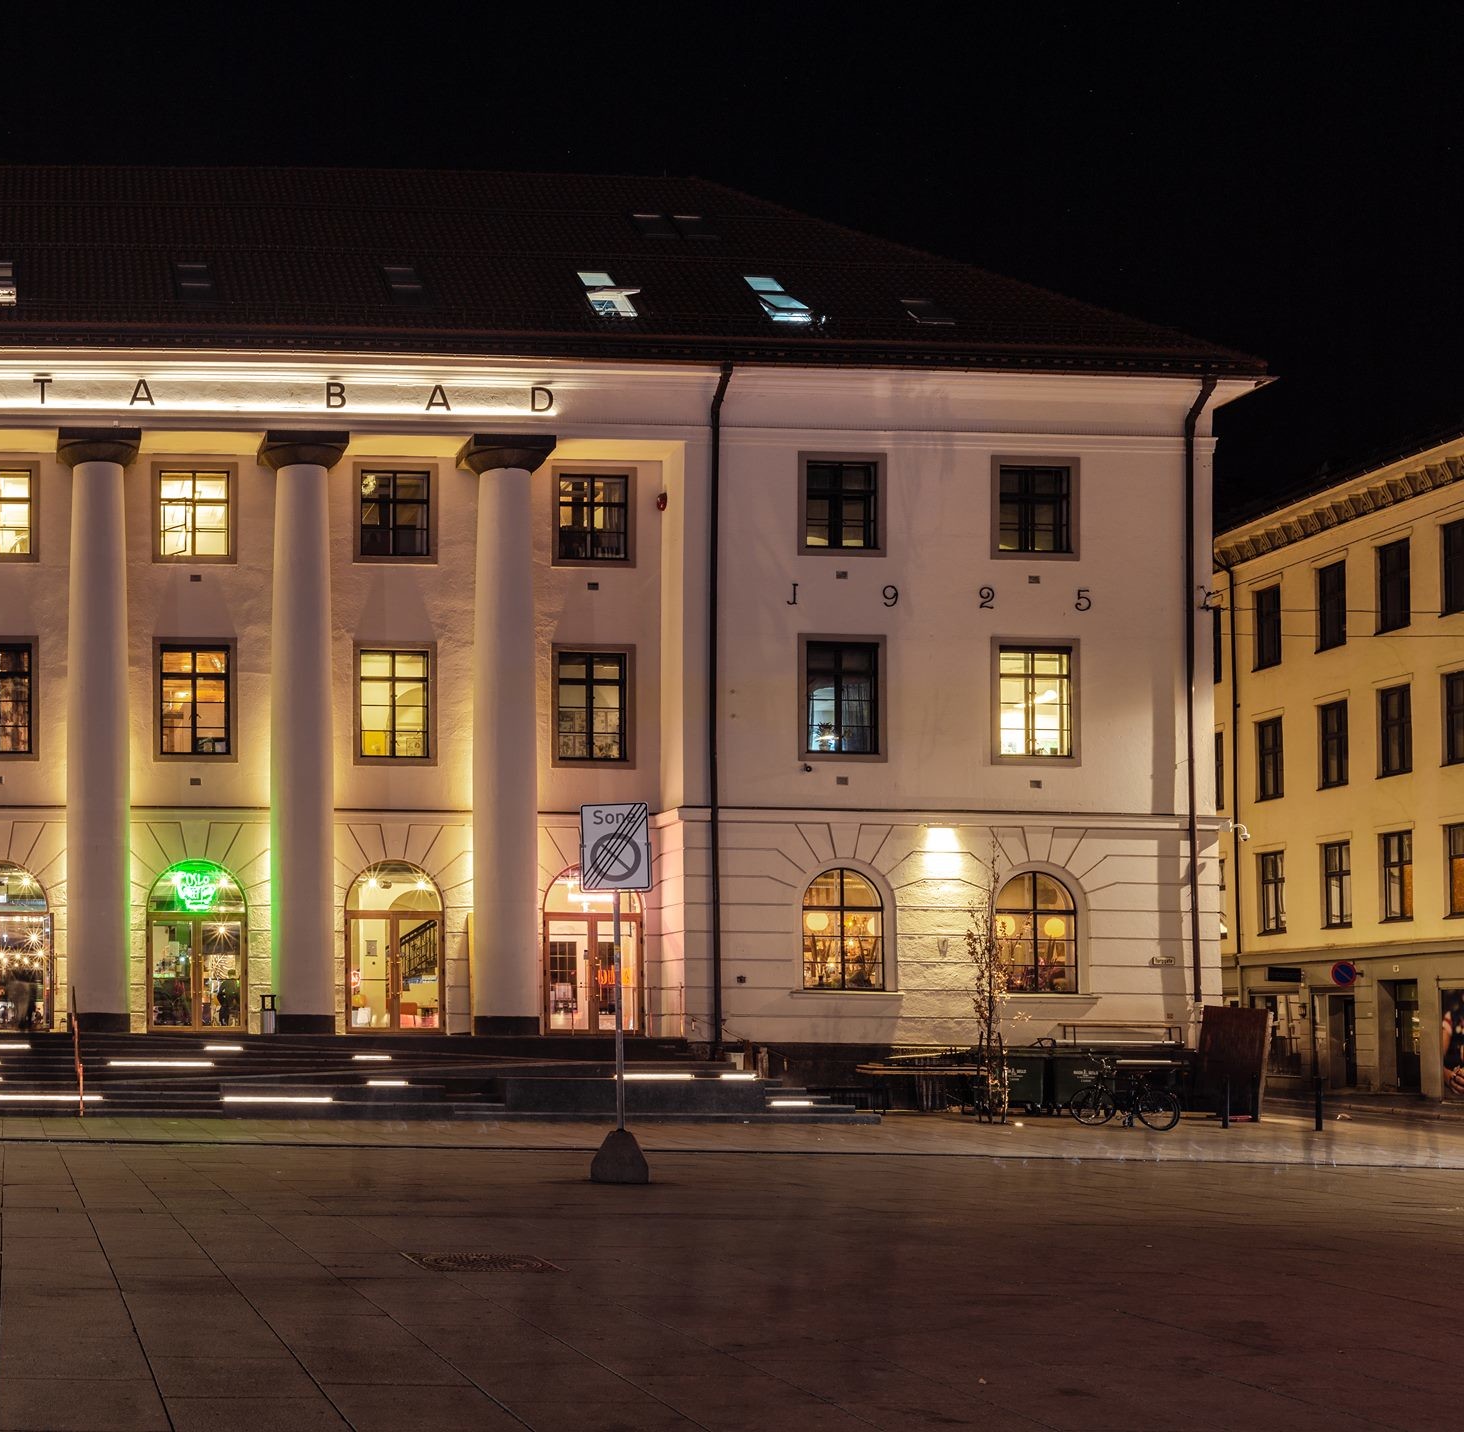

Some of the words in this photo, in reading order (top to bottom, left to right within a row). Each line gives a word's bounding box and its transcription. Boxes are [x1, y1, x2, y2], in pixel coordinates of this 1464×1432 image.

[325, 380, 557, 413] BAD
[786, 583, 1092, 612] 1925
[592, 809, 637, 825] Sone
